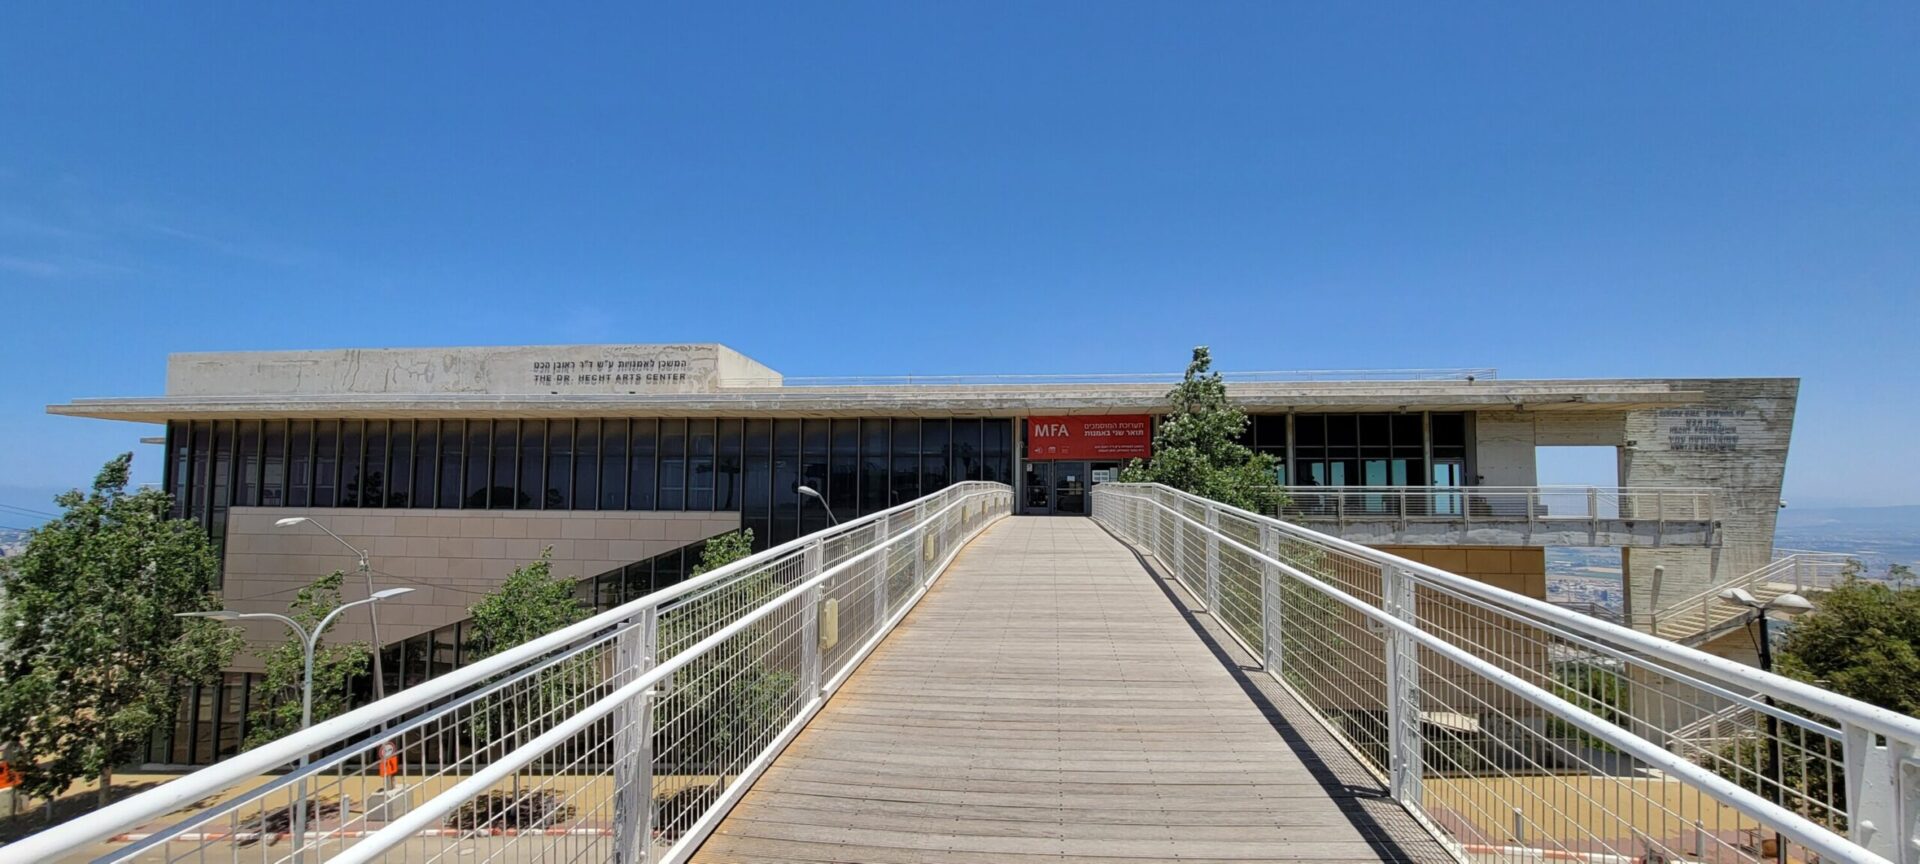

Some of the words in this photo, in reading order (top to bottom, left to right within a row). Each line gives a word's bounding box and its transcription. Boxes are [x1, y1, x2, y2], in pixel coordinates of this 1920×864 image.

[534, 361, 550, 369] הכט
[553, 361, 575, 371] ראובן
[618, 359, 655, 369] לאמנויות
[658, 360, 687, 370] המשכן
[534, 374, 551, 382] THE
[557, 374, 574, 382] DR.
[646, 373, 686, 381] CENTER
[1034, 424, 1069, 437] MFA
